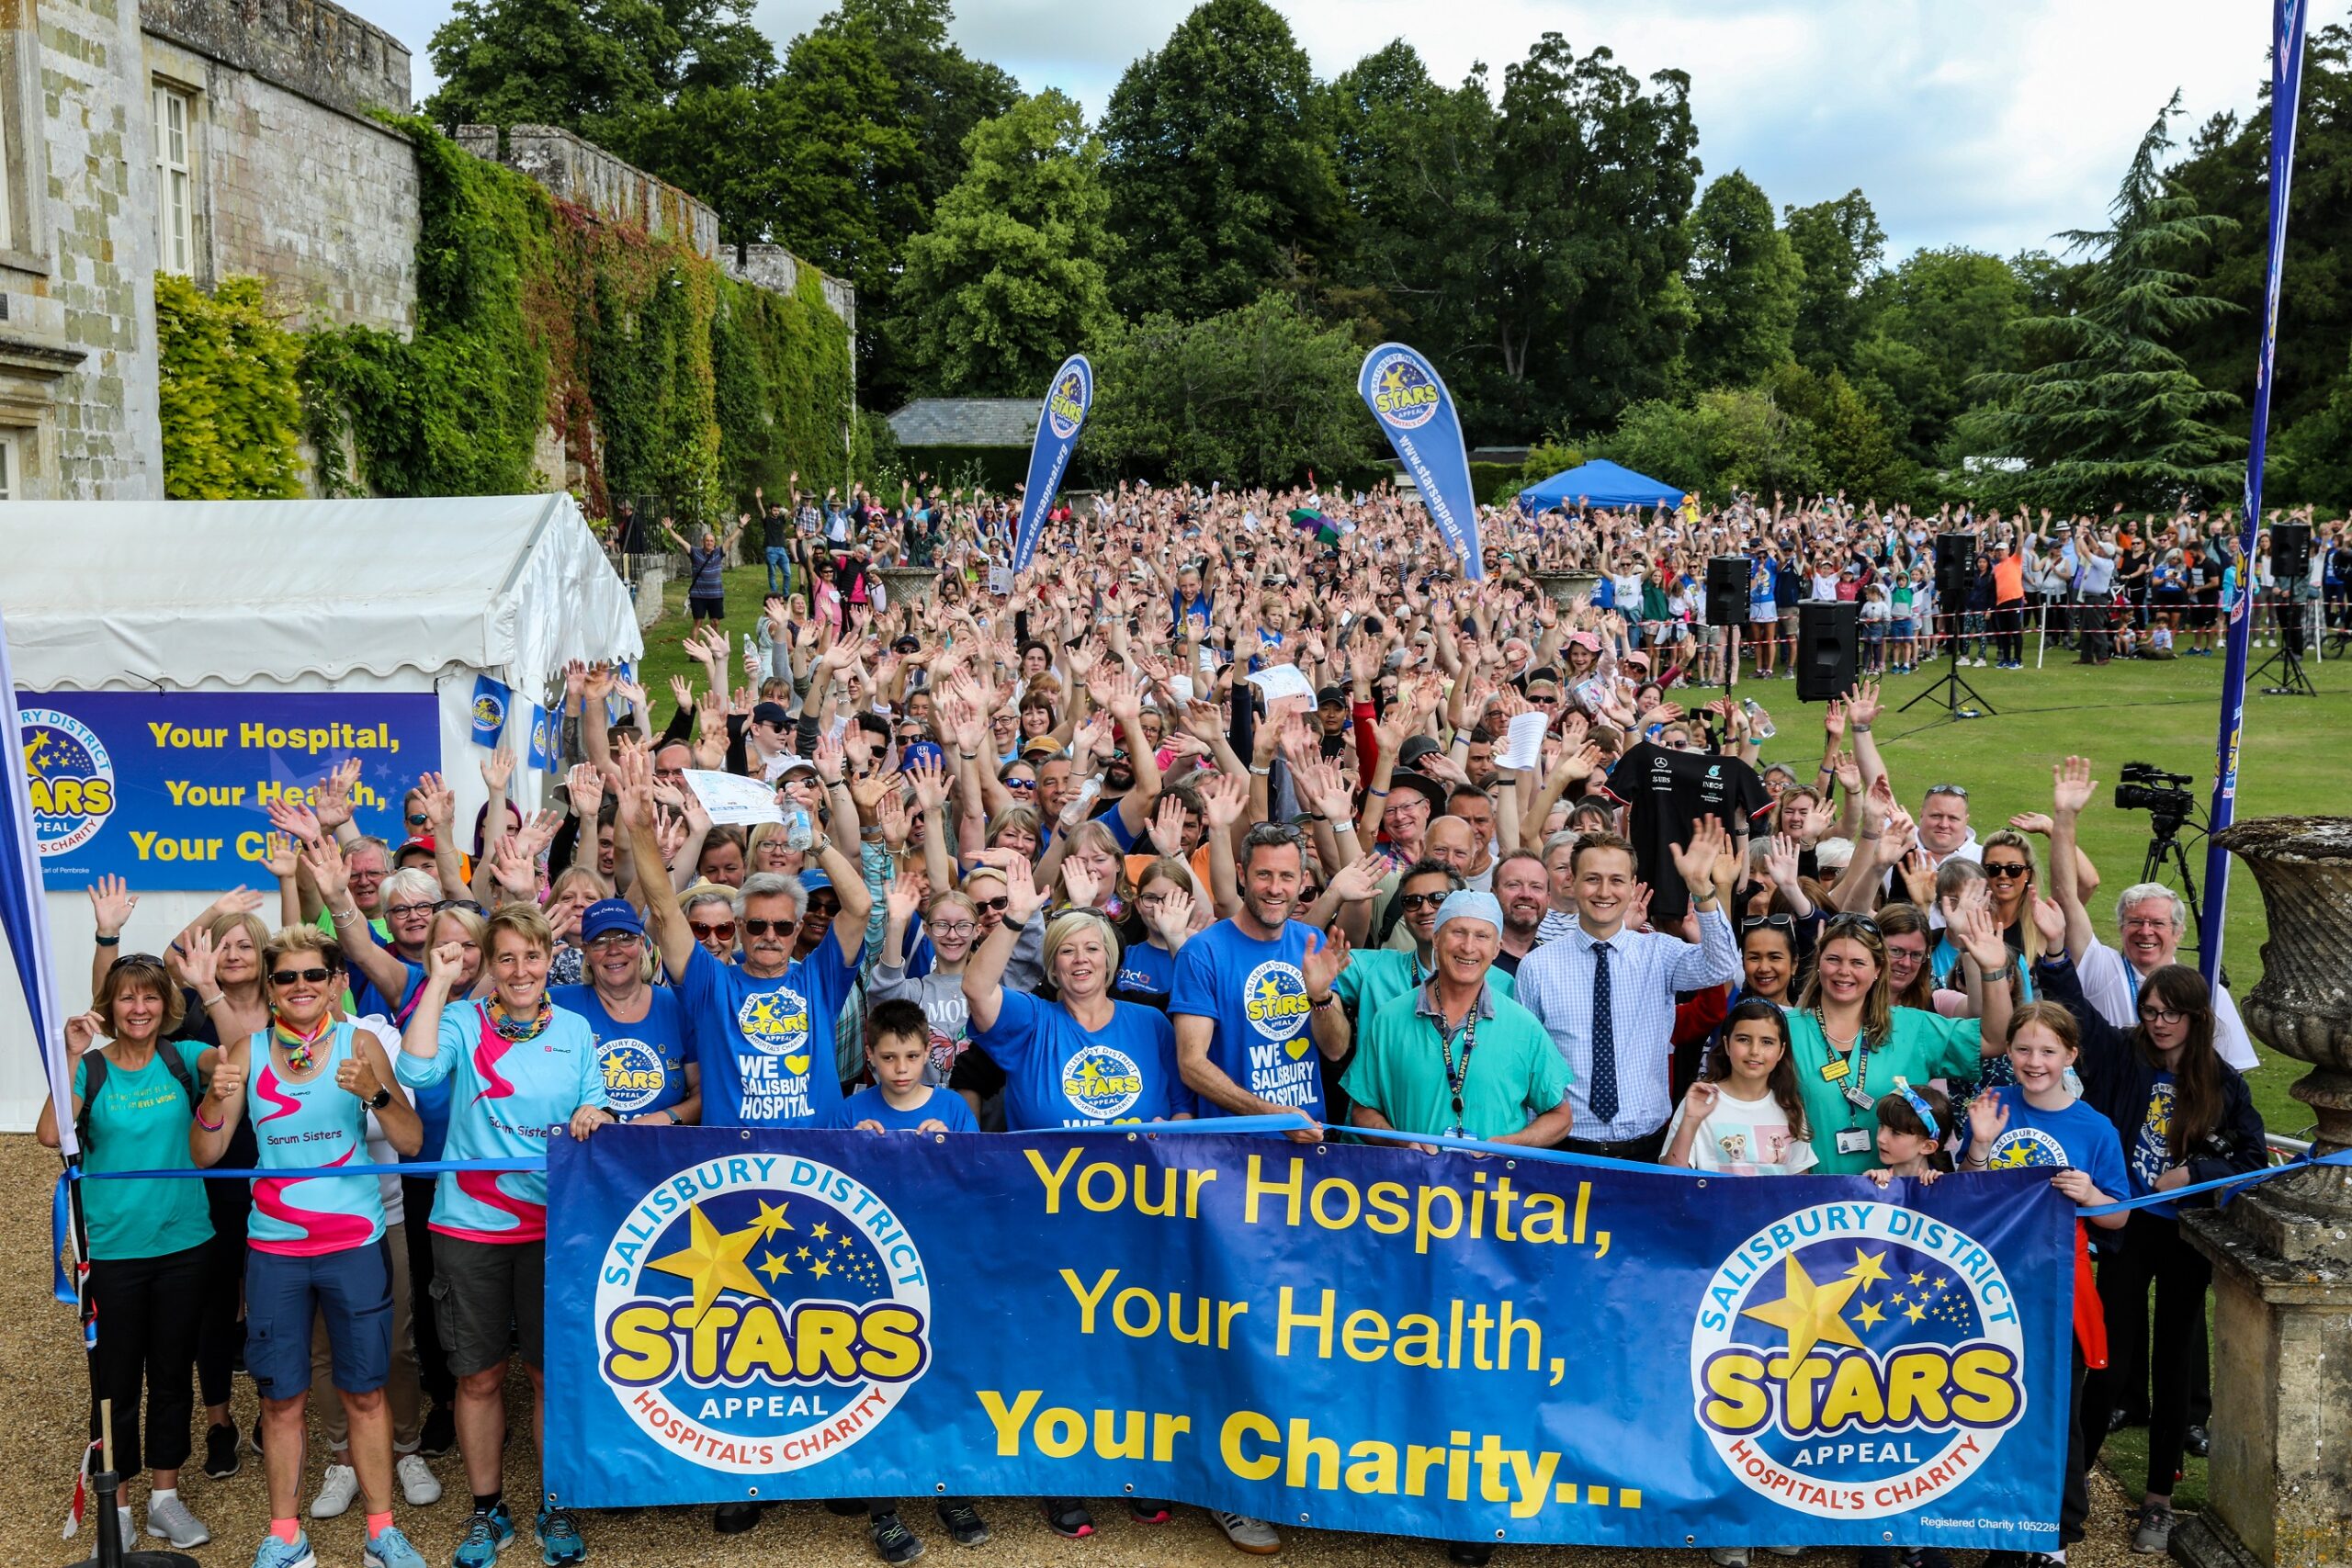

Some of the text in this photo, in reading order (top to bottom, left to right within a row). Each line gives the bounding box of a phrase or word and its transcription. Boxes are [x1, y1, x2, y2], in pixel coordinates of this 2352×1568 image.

[1050, 394, 1082, 424] STARS
[1375, 384, 1439, 412] STARS
[1398, 408, 1424, 418] APPEAL
[1018, 444, 1069, 570] www.starsappeal.org
[1399, 434, 1471, 561] www.starsappeal.rg
[49, 712, 110, 771] DISTRICT
[147, 722, 400, 755] Your Hospital,
[29, 779, 113, 816] ARS
[164, 780, 246, 806] Your
[1702, 781, 1724, 790] INEOS
[36, 822, 72, 832] PEAL
[51, 818, 96, 852] CHARITY
[129, 831, 223, 861] Your
[1274, 964, 1306, 986] DISTRIC
[742, 1012, 808, 1035] STARS
[1282, 1016, 1303, 1036] CHARITY
[1467, 1011, 1476, 1032] STARS
[598, 1040, 662, 1069] LISBURY DISTRICT
[782, 1034, 804, 1051] CHARITY
[739, 1055, 779, 1079] WE
[1102, 1048, 1137, 1073] DISTRICT
[1250, 1043, 1282, 1070] WE
[1459, 1054, 1469, 1078] APPEAL
[1859, 1055, 1867, 1074] STARS
[603, 1071, 664, 1090] TARS
[1065, 1077, 1141, 1098] STARS
[1251, 1061, 1315, 1090] SALISBURY
[629, 1091, 655, 1108] CHARITY
[740, 1095, 815, 1120] HOSPITAL
[1088, 1098, 1119, 1106] APPEAL
[1109, 1095, 1134, 1114] CHARITY
[267, 1130, 343, 1145] Sarum Sisters
[517, 1125, 547, 1138] Siste
[1991, 1130, 2068, 1167] SALISBURY DISTRIC
[1023, 1146, 1611, 1258] Your Hospital,
[604, 1157, 925, 1287] SALISBURY DISTRICT
[1701, 1204, 2018, 1332] SALISBURY DISTRICT
[1058, 1269, 1566, 1386] Your Health,
[606, 1305, 926, 1385] STARS
[1701, 1342, 2019, 1437] STARS
[698, 1395, 829, 1420] APPEAL
[632, 1387, 888, 1465] HOSPITAL'S CHARITY
[976, 1390, 1642, 1518] Your Charity...
[1792, 1442, 1920, 1467] APPEAL
[1728, 1434, 1984, 1509] HOSPITAL'S CHARITY
[1920, 1517, 2060, 1533] Registered Charity 1052284
